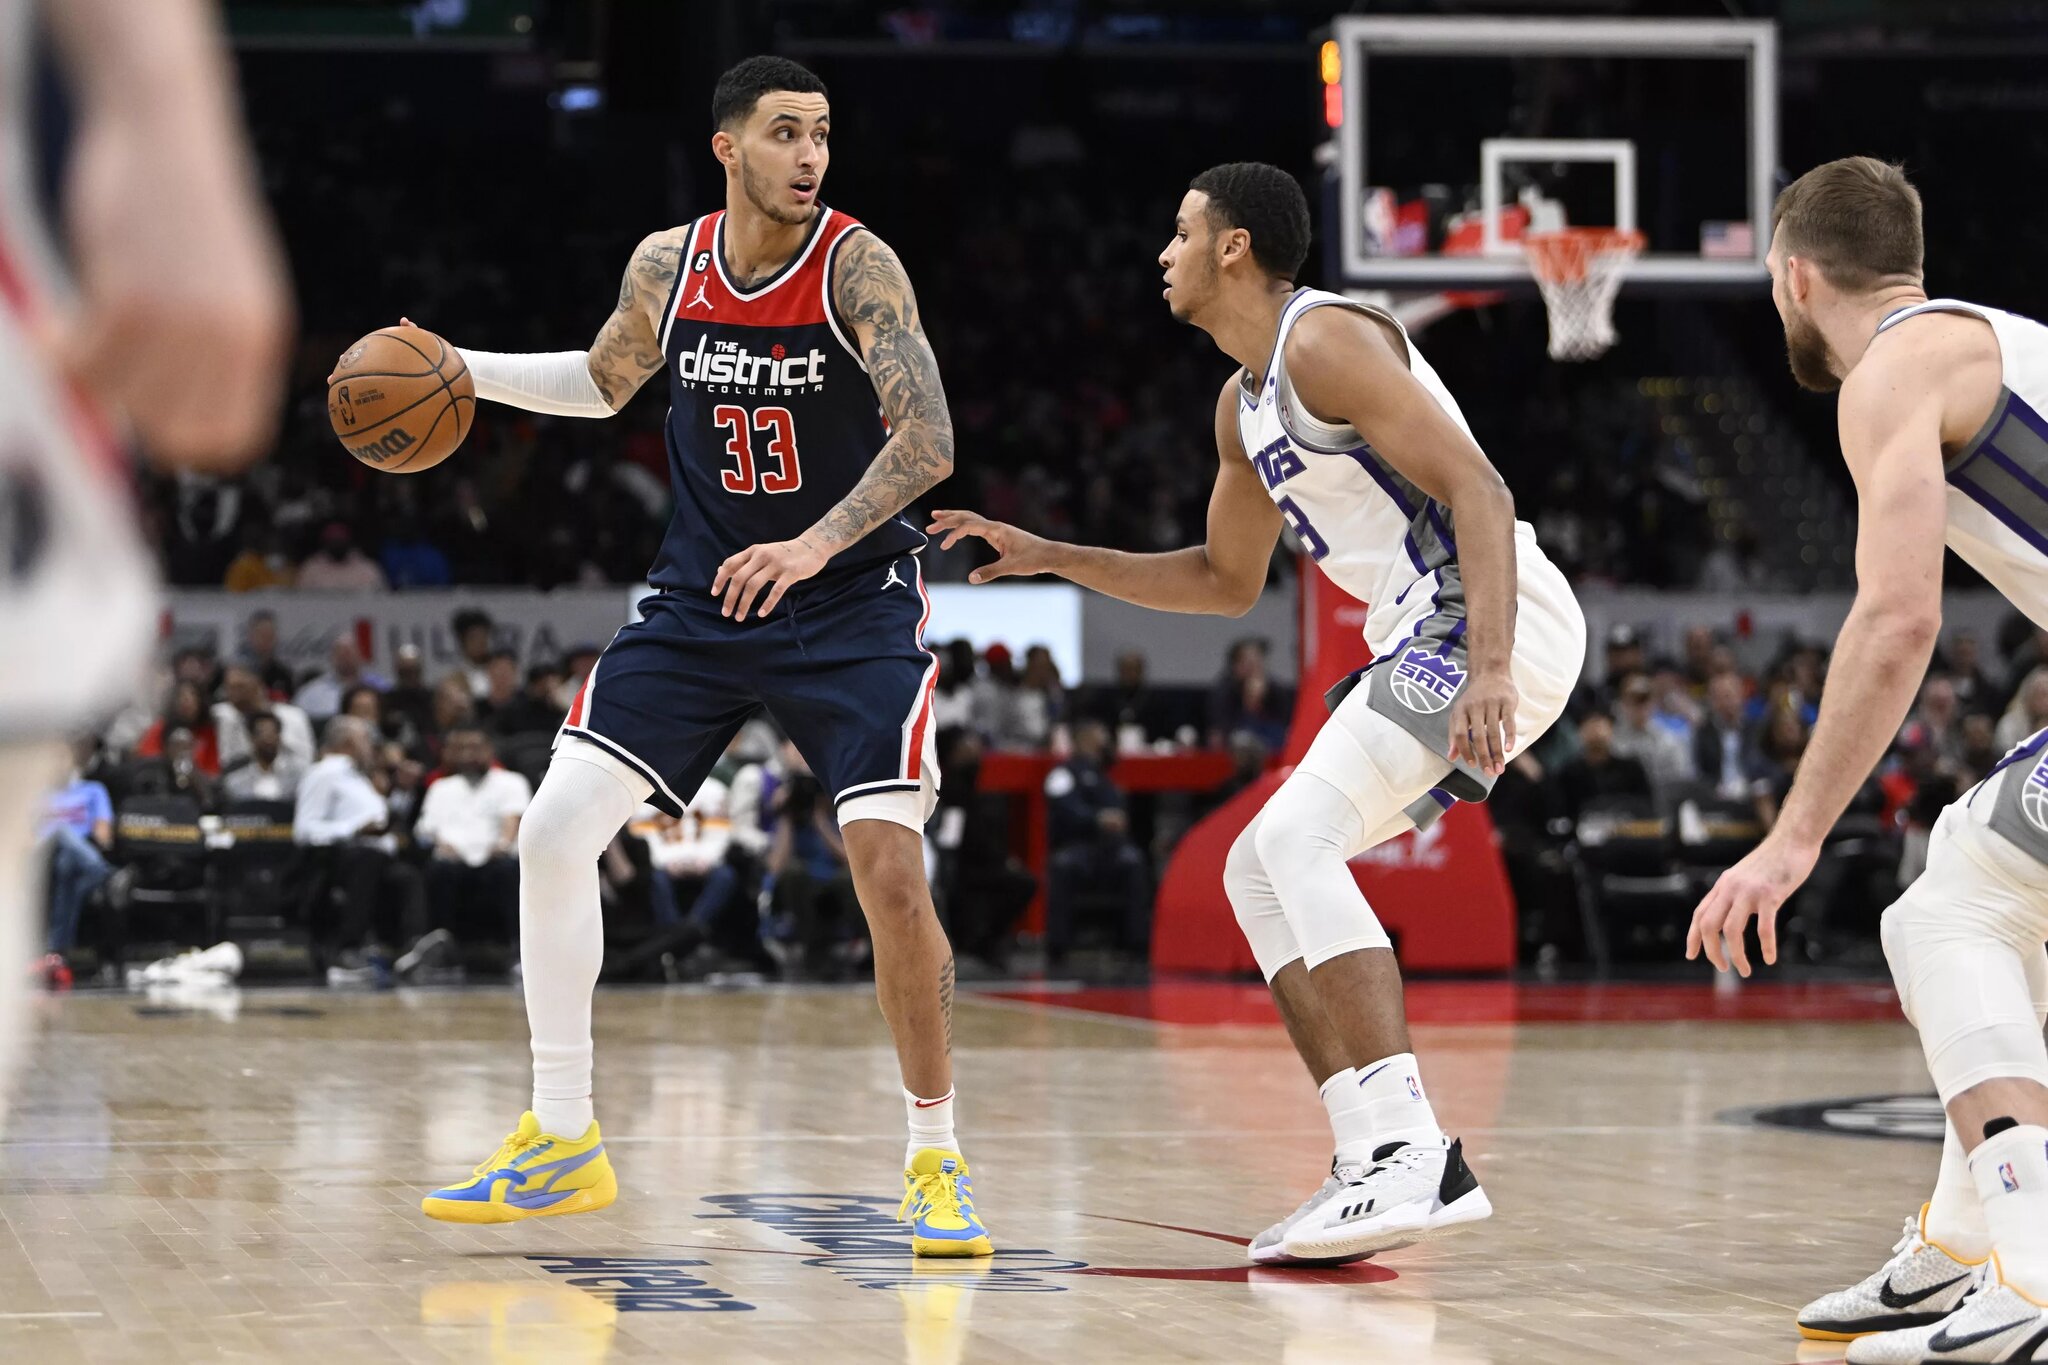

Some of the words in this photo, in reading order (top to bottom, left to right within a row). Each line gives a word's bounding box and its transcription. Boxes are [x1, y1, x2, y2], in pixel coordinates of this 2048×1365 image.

[695, 252, 710, 271] 6
[679, 333, 826, 386] district
[714, 341, 739, 353] THE
[682, 380, 696, 390] OF
[707, 384, 823, 396] COLUMBIA
[713, 404, 802, 495] 33
[1395, 661, 1455, 702] SAC
[525, 1256, 757, 1312] Arena
